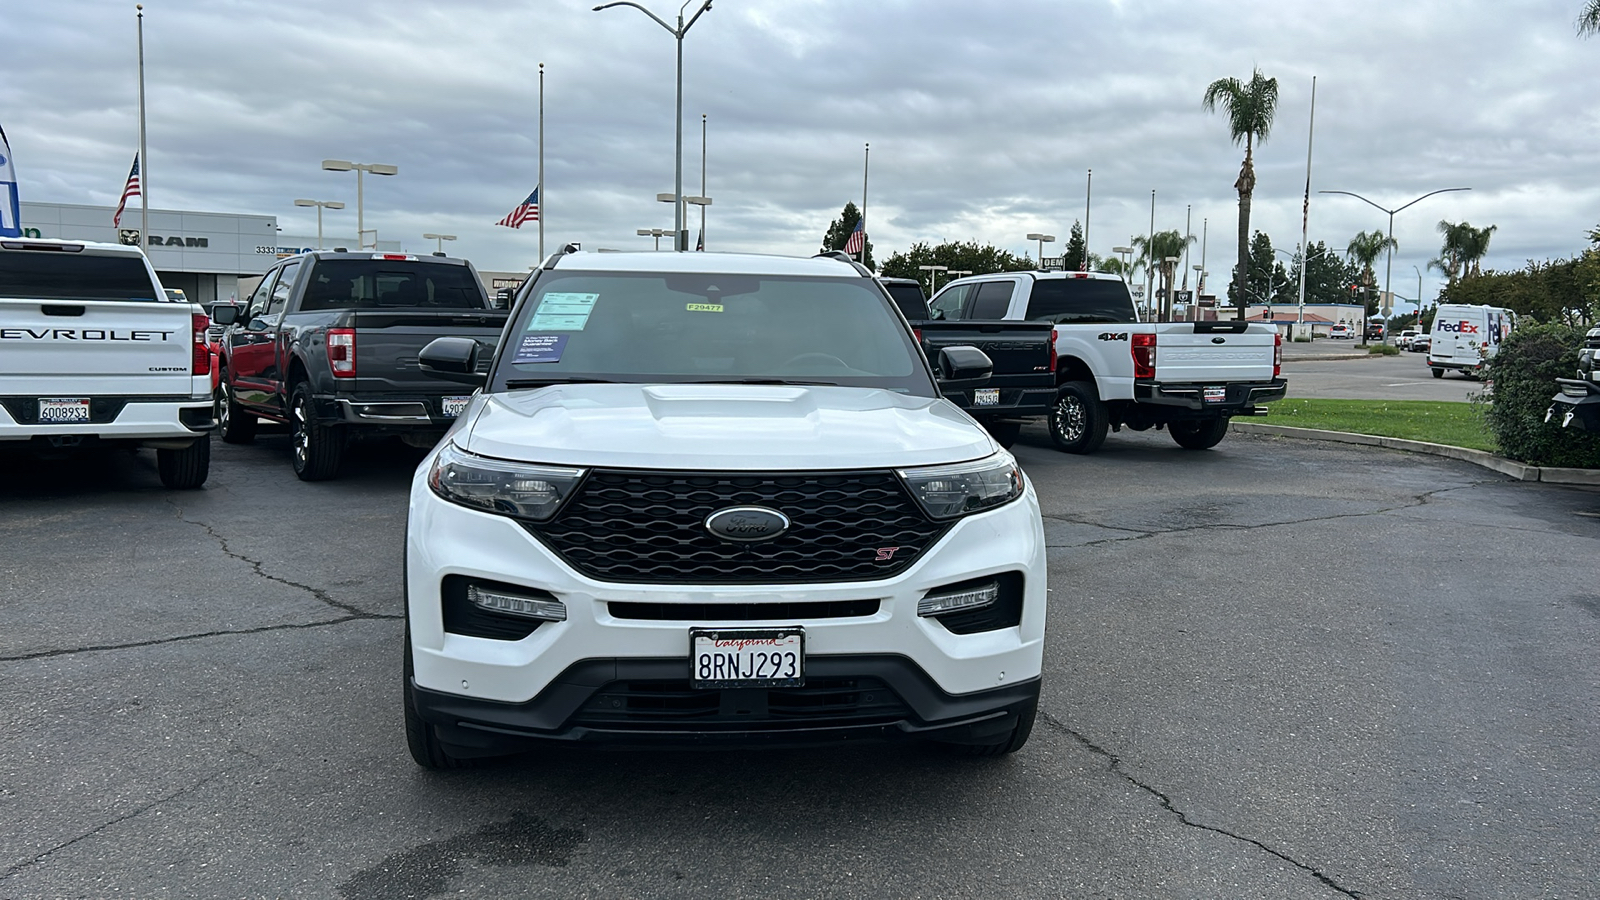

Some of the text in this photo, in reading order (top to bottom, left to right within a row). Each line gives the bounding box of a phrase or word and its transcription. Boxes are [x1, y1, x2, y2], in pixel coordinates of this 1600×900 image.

[148, 236, 208, 247] RAM
[256, 246, 276, 254] 3333
[1044, 259, 1063, 267] OEM
[1437, 320, 1479, 333] FedEx
[42, 407, 87, 418] 60089S3
[726, 515, 769, 533] Ford
[875, 547, 900, 561] ST
[715, 638, 783, 651] California
[699, 652, 796, 679] 8RNJ293
